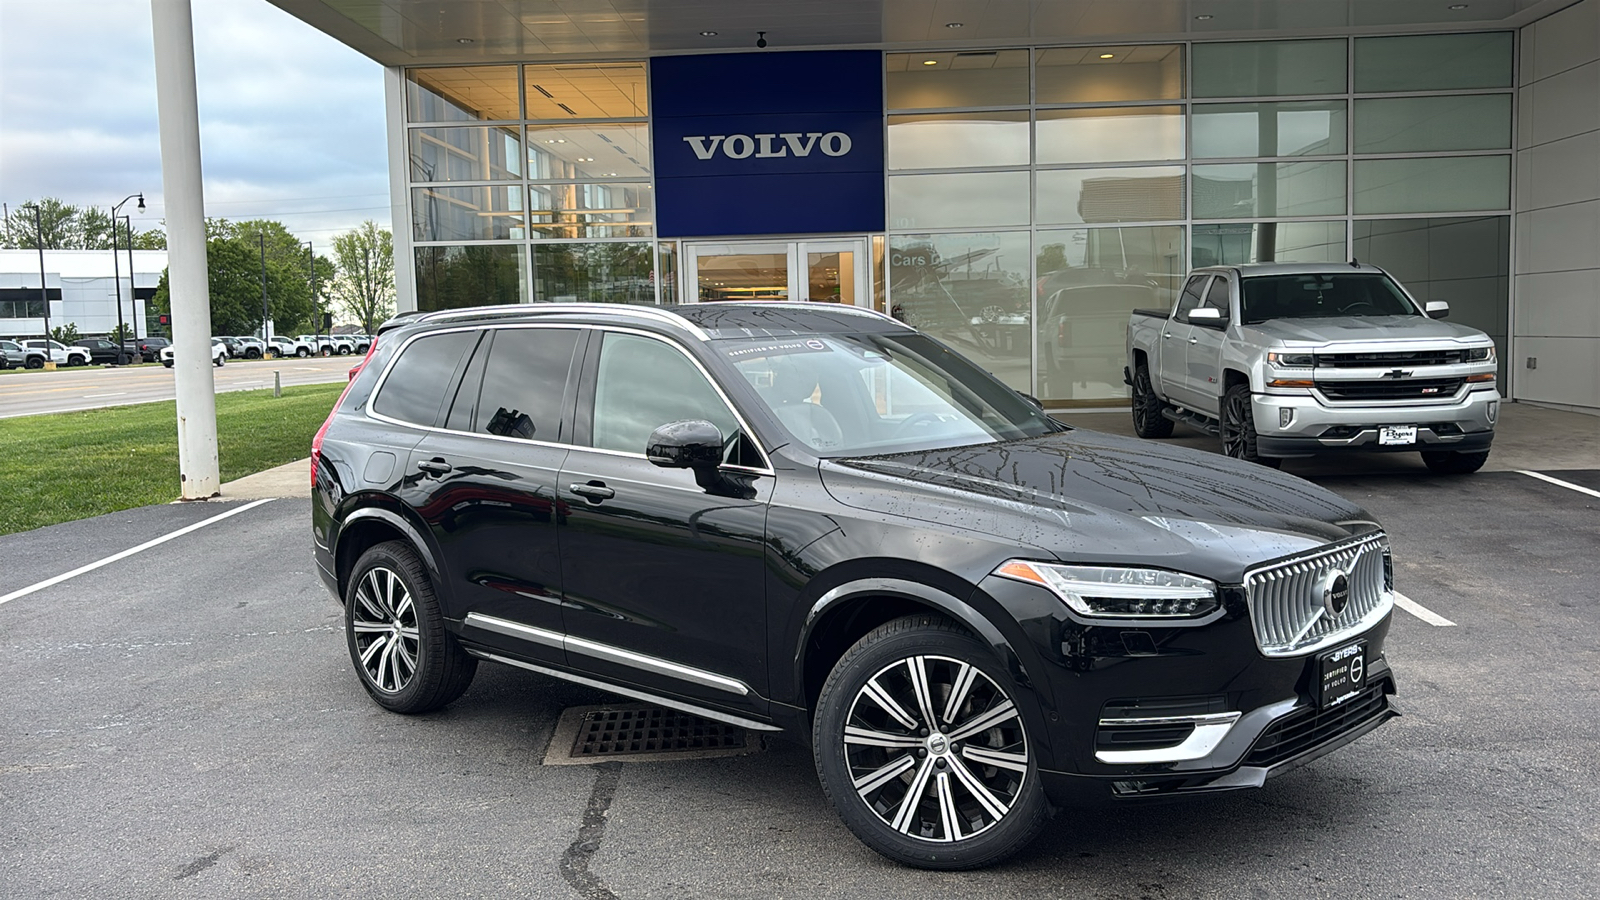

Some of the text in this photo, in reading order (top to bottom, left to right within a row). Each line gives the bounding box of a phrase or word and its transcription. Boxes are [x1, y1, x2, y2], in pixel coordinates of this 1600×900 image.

[683, 131, 852, 160] VOLVO
[891, 253, 926, 266] Cars
[728, 347, 767, 357] CERTIFIED
[1334, 644, 1358, 662] BYERS
[1324, 666, 1348, 681] CERTIFIED
[1324, 676, 1347, 691] BY VOLVO
